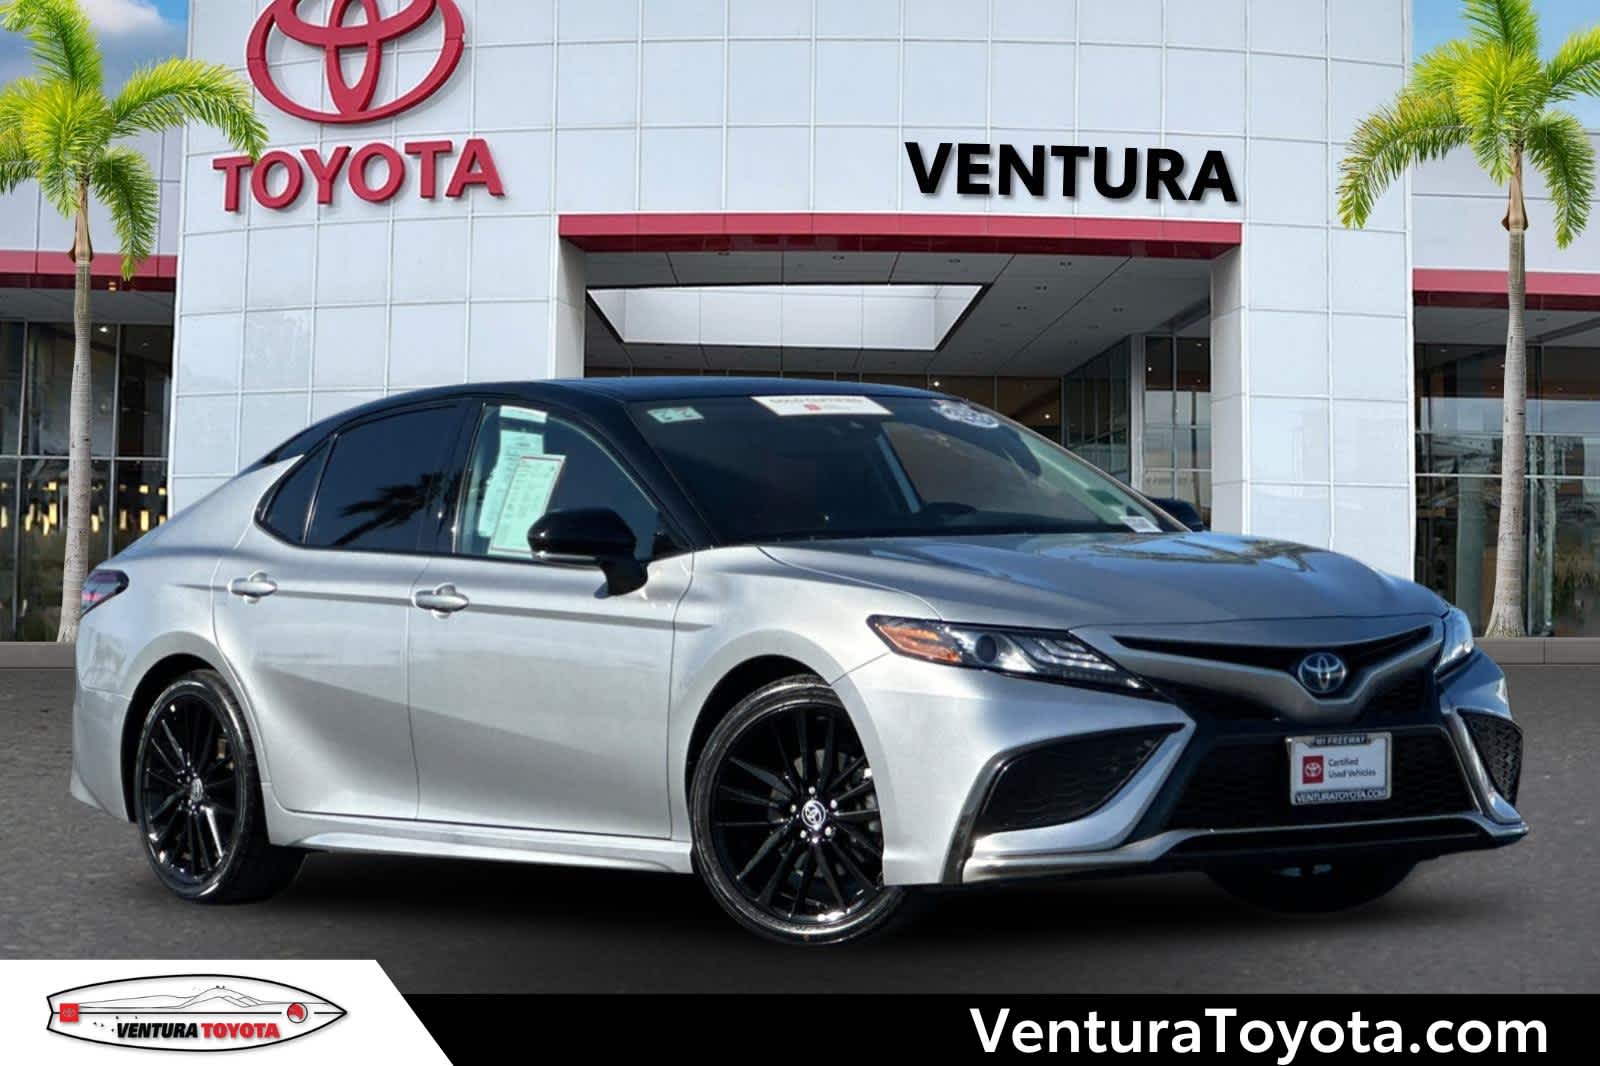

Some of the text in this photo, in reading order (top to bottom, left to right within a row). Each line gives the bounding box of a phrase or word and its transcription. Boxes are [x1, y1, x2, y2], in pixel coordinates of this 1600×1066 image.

[213, 138, 505, 212] TOYOTA
[904, 141, 1238, 202] VENTURA
[1328, 757, 1359, 767] Certified
[1328, 768, 1376, 779] Used Vehicles
[1296, 789, 1386, 802] VENTURATOYOTA.COM
